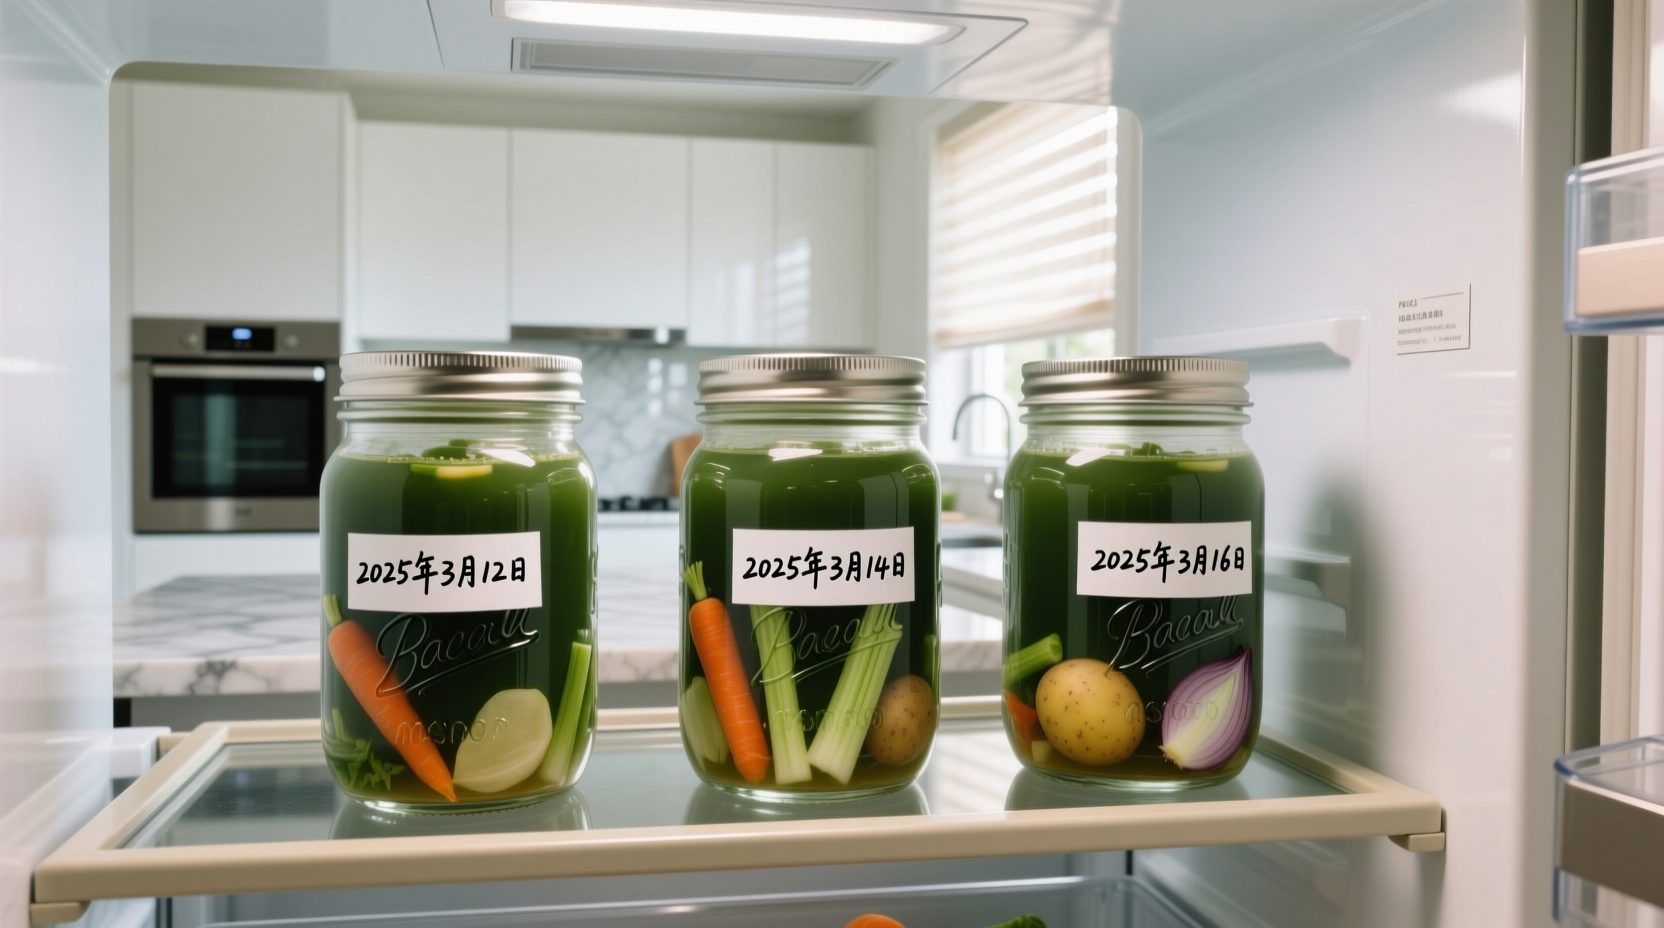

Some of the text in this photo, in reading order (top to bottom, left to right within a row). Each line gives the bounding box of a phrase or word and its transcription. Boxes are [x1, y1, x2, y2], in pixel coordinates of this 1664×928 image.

[356, 550, 526, 596] 2025年3月12日
[742, 546, 905, 590] 2025年3月14日
[1090, 540, 1245, 584] 2025年3月16日
